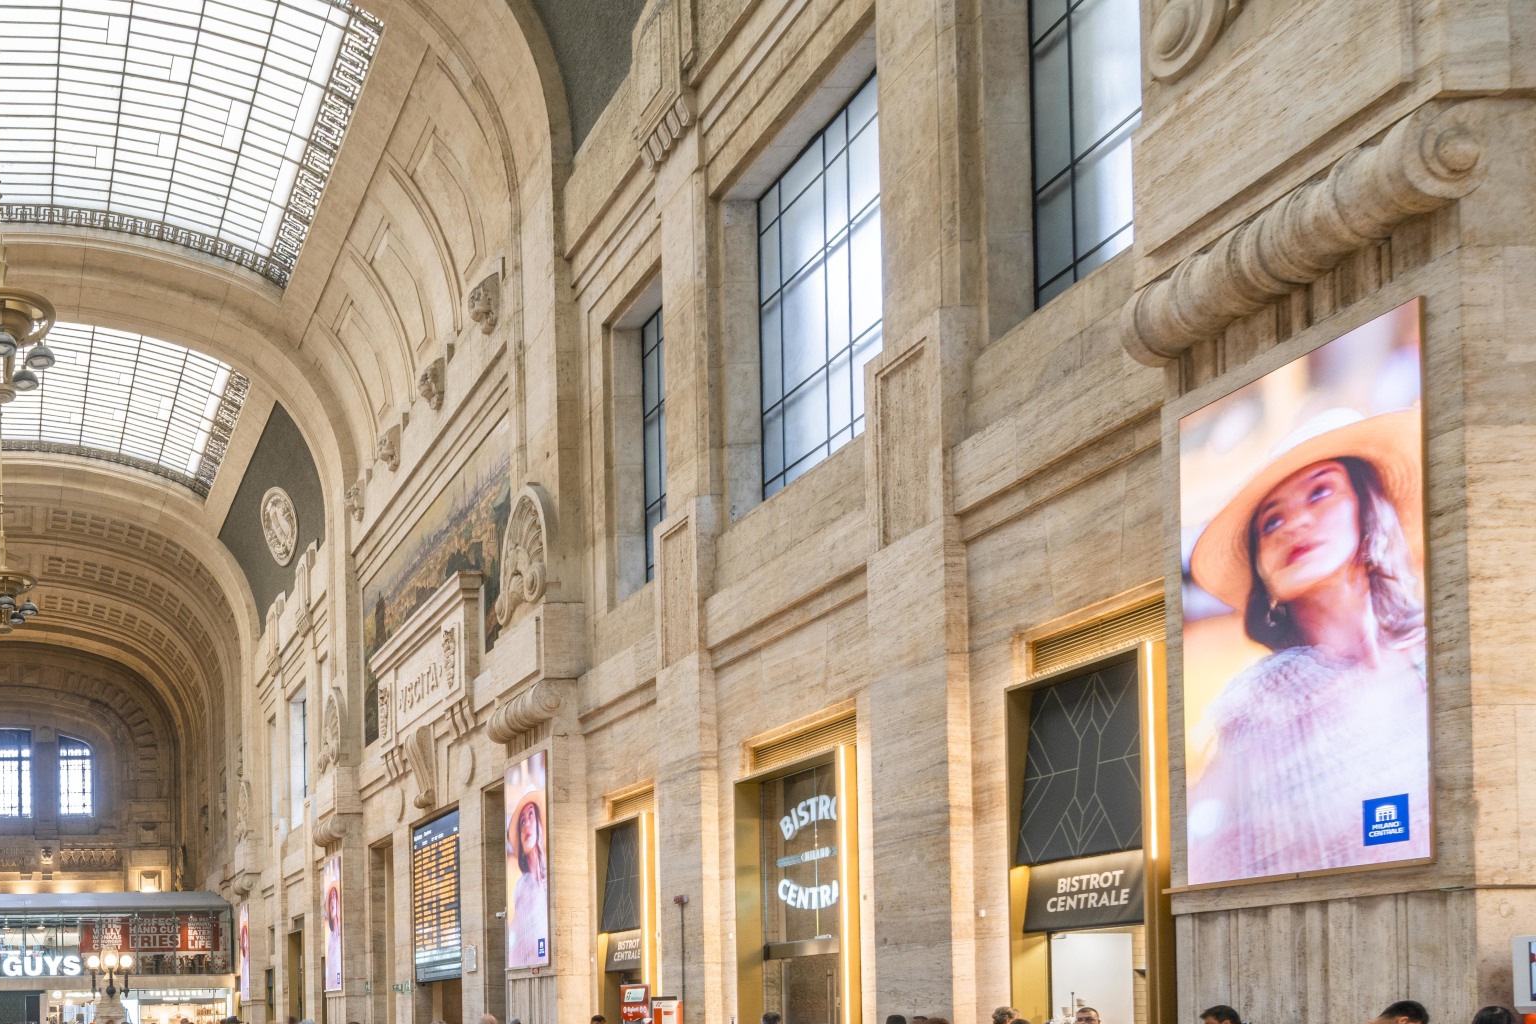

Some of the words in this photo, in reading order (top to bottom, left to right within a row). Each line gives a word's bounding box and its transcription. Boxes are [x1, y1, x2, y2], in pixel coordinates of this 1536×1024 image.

[1372, 821, 1401, 830] MILANO
[1368, 827, 1404, 837] CENTRALE
[1057, 870, 1125, 894] BISTROT
[1046, 888, 1130, 913] CENTRALE
[129, 926, 157, 934] HAND
[159, 926, 180, 934] CUT
[130, 935, 180, 947] FRIES
[187, 940, 212, 949] LIFE
[617, 938, 640, 950] BISTROT
[613, 949, 641, 962] CENTRALE
[2, 955, 81, 977] GUYS
